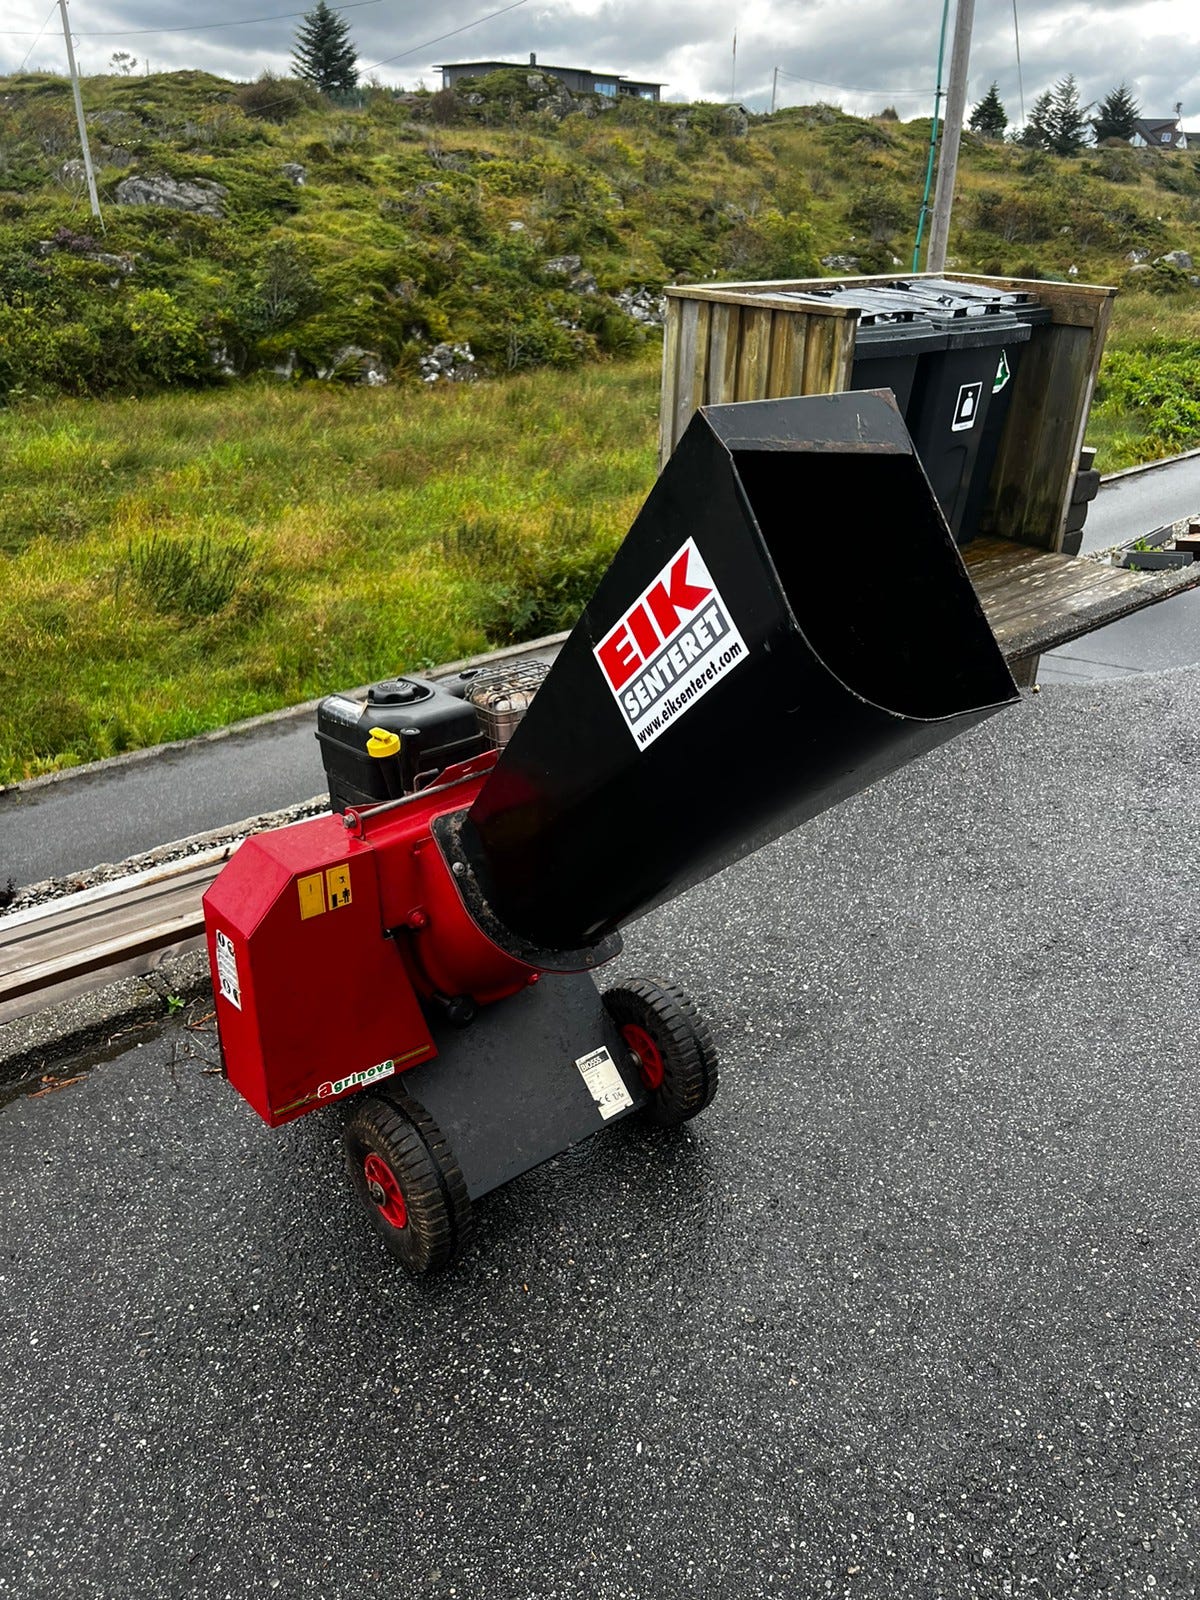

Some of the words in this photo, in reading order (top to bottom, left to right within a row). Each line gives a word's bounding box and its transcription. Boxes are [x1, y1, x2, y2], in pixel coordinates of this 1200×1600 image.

[598, 547, 713, 691] EIK
[623, 604, 724, 719] SENTERET
[637, 642, 742, 743] www.eiksenteret.com
[318, 1061, 393, 1098] agrinova
